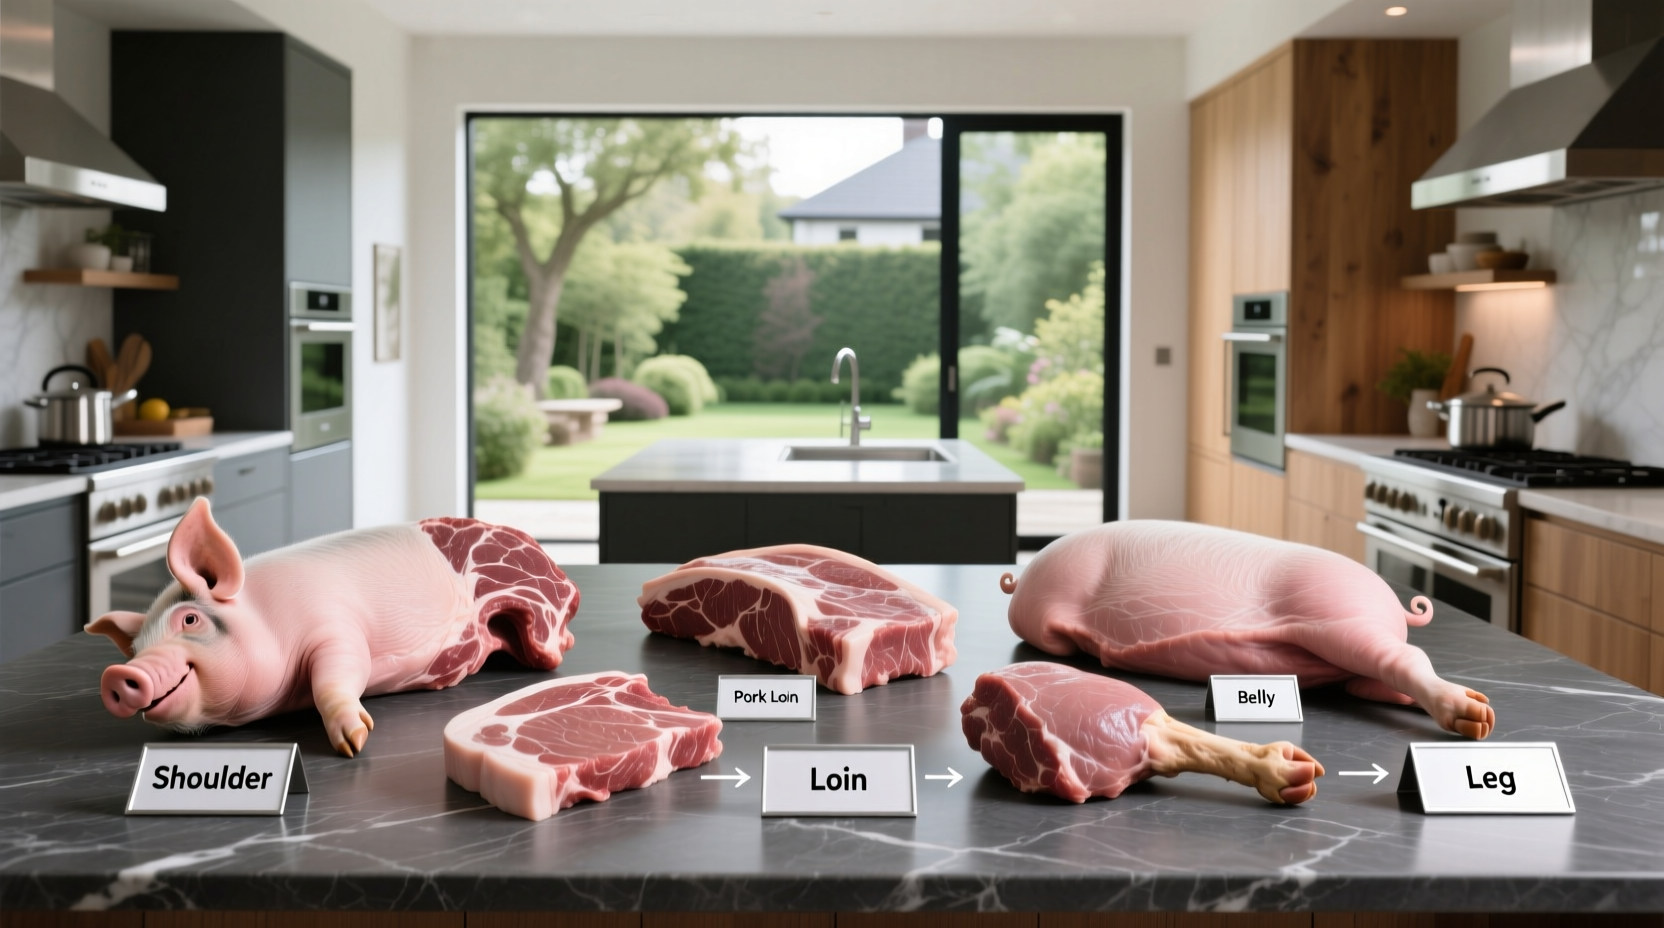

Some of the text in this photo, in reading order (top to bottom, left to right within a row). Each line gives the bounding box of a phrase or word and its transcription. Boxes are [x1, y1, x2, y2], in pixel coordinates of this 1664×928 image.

[734, 689, 799, 704] Pork Loin
[1238, 689, 1276, 708] Belly
[152, 764, 273, 790] Shoulder
[810, 766, 867, 791] Loin
[1466, 765, 1517, 796] Leg
